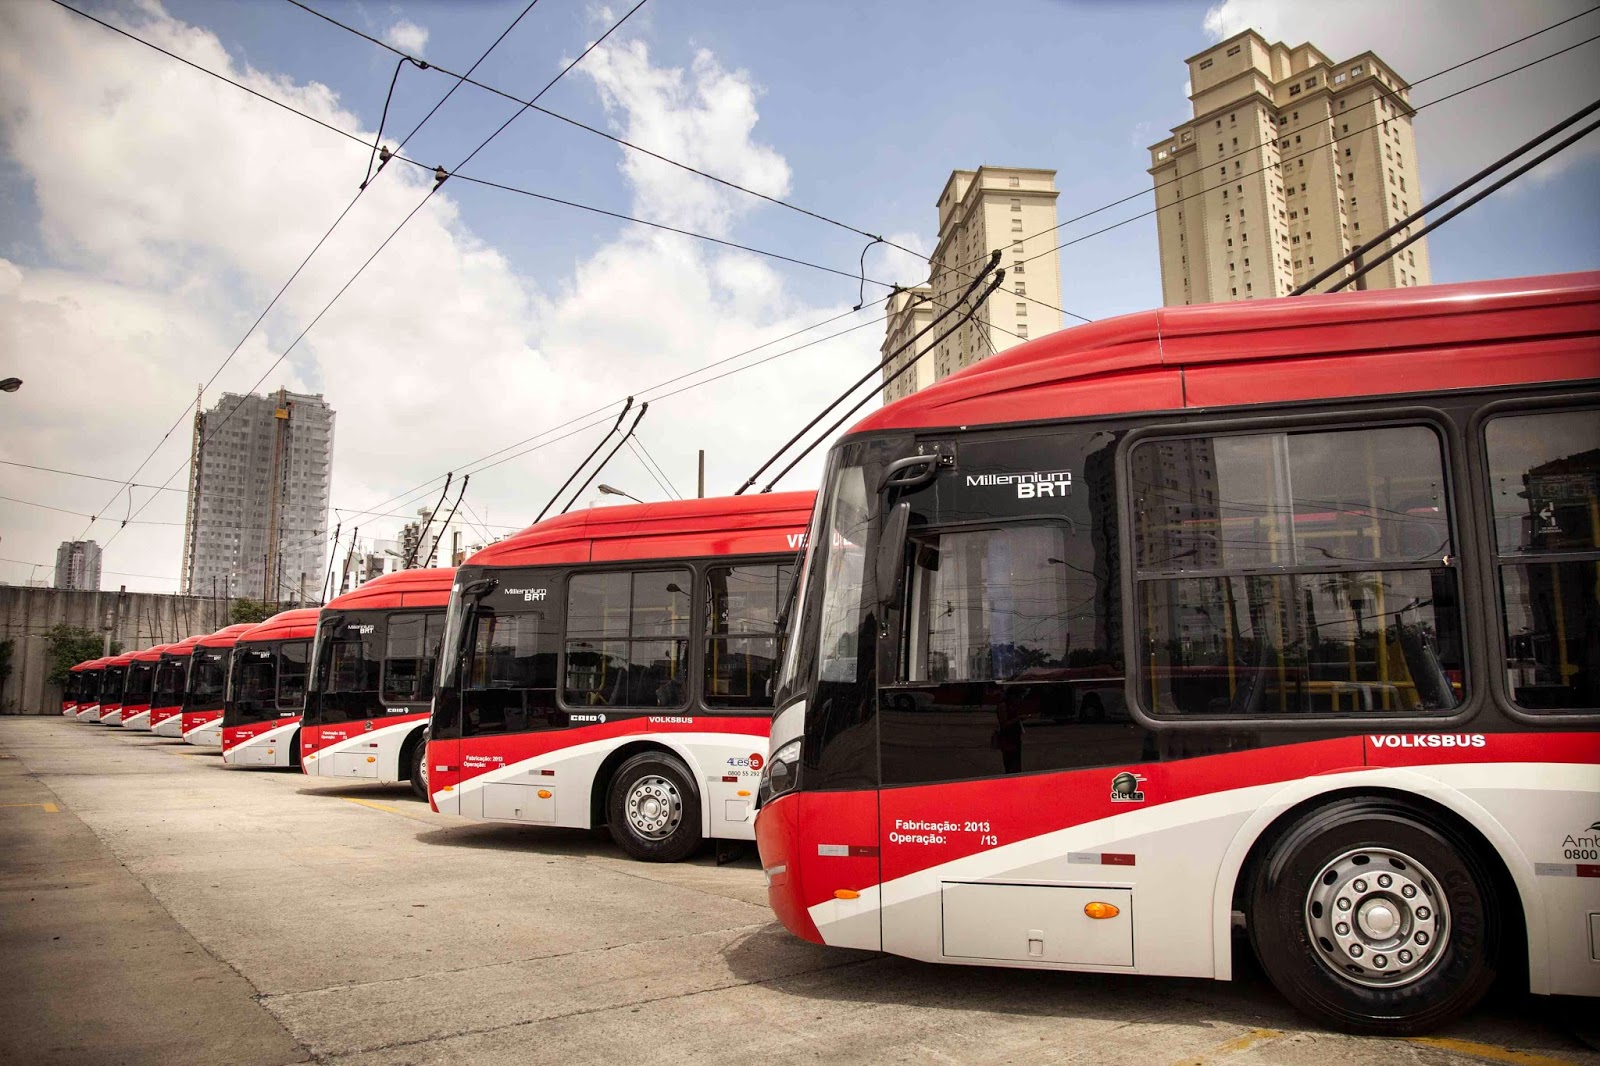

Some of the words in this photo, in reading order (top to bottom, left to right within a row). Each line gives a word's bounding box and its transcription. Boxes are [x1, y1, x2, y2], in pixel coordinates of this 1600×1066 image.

[966, 472, 1072, 487] Millennium
[1017, 481, 1072, 499] BRT
[504, 587, 547, 595] Millennium
[524, 593, 547, 601] BRT
[570, 714, 597, 722] CAIO
[649, 716, 693, 724] VOLKSBUS
[1370, 734, 1486, 747] VOLKSBUS
[1111, 790, 1143, 799] eletra
[895, 819, 961, 833] Fabricação:
[964, 821, 991, 833] 2013
[889, 832, 947, 846] Operação:
[980, 835, 998, 846] /13
[1564, 849, 1598, 860] 0800
